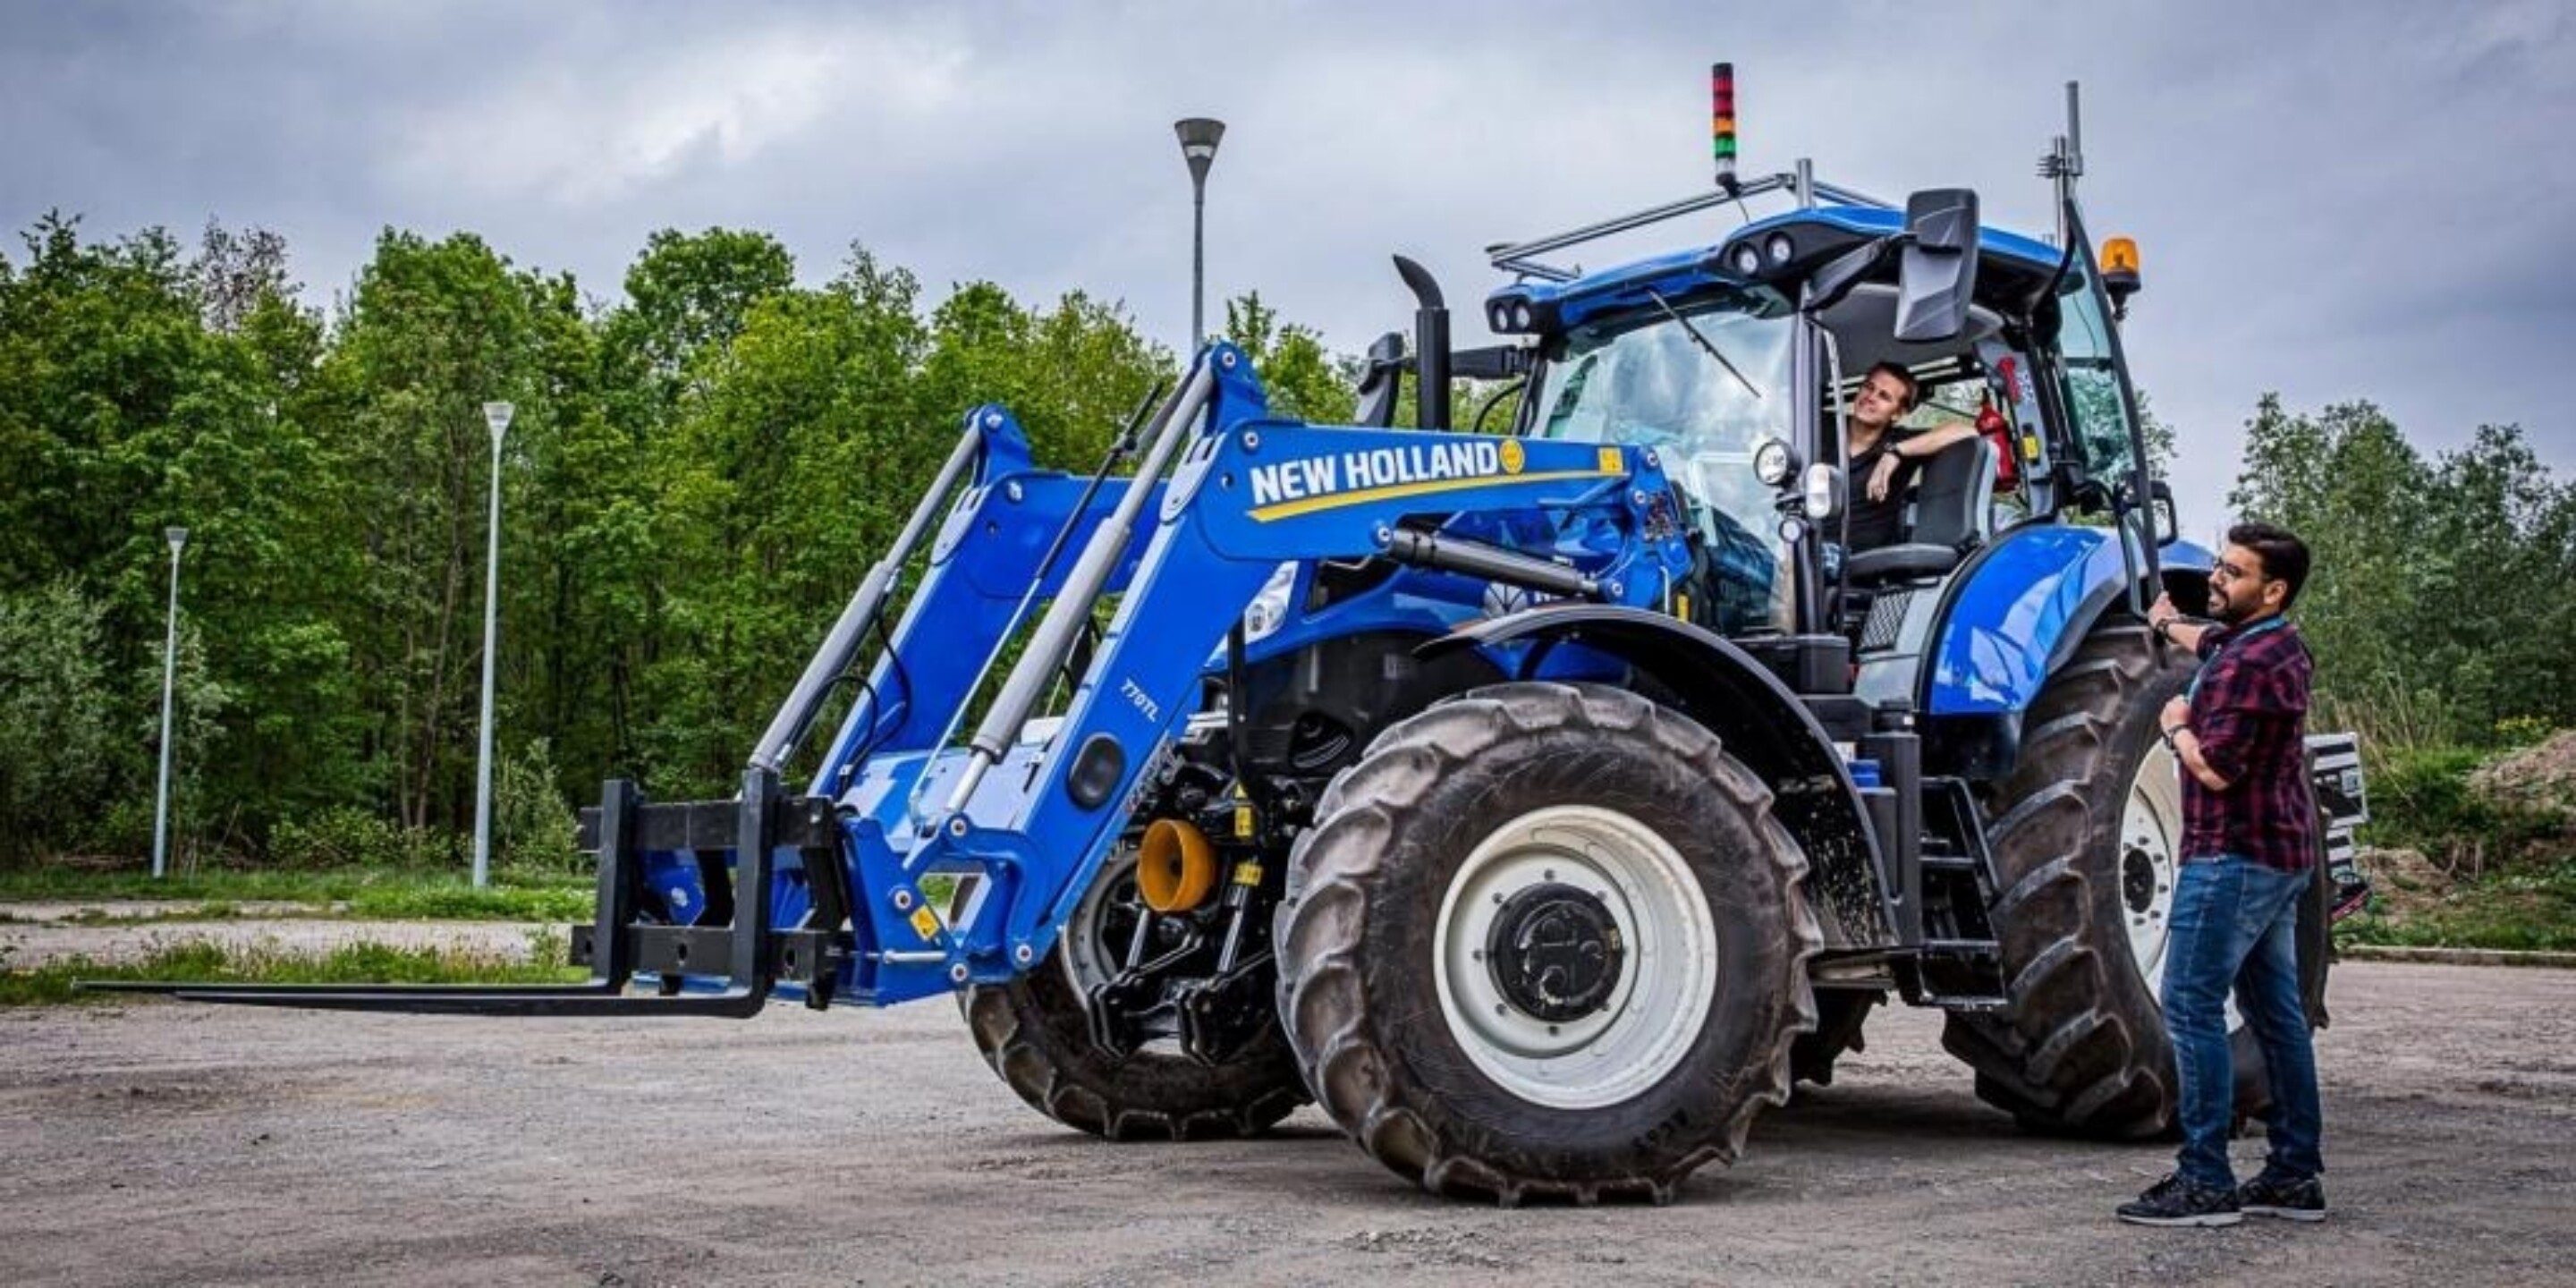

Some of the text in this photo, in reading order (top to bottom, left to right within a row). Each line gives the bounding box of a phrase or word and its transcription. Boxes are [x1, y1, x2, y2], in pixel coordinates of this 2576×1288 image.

[1250, 442, 1499, 504] NEW HOLLAND
[1121, 677, 1158, 723] 770TL
